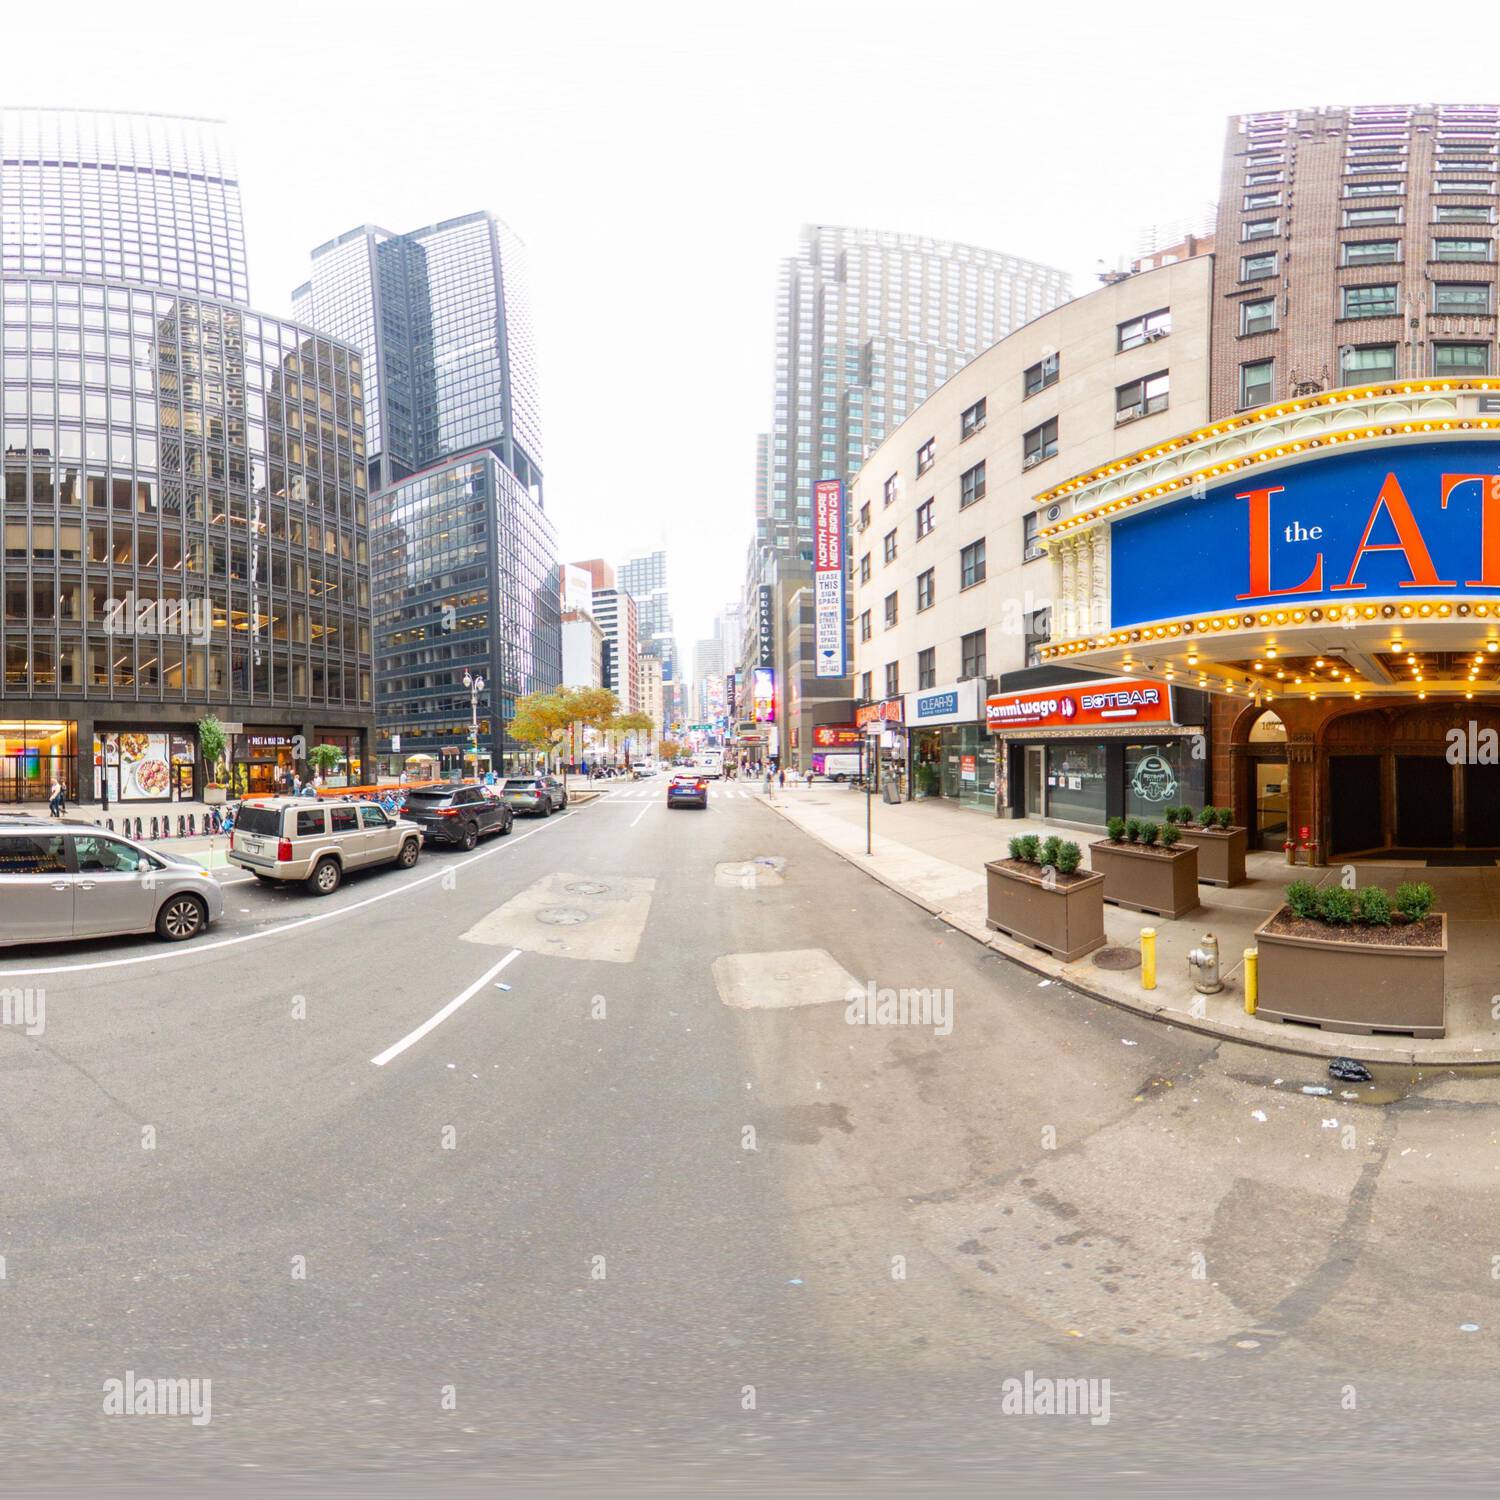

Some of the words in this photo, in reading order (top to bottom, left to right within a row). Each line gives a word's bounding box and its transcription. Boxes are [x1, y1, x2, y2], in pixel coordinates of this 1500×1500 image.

[829, 491, 838, 507] CO.
[817, 492, 827, 527] SHORE
[829, 509, 838, 533] SIGN
[1284, 520, 1323, 543] the
[818, 528, 828, 567] NORTH
[829, 536, 838, 568] NEON
[820, 580, 838, 589] THIS
[818, 597, 839, 605] SPACE
[920, 694, 954, 711] CLEAR-19
[986, 699, 1058, 718] Sanmiwago
[1081, 689, 1159, 709] BOTBAR
